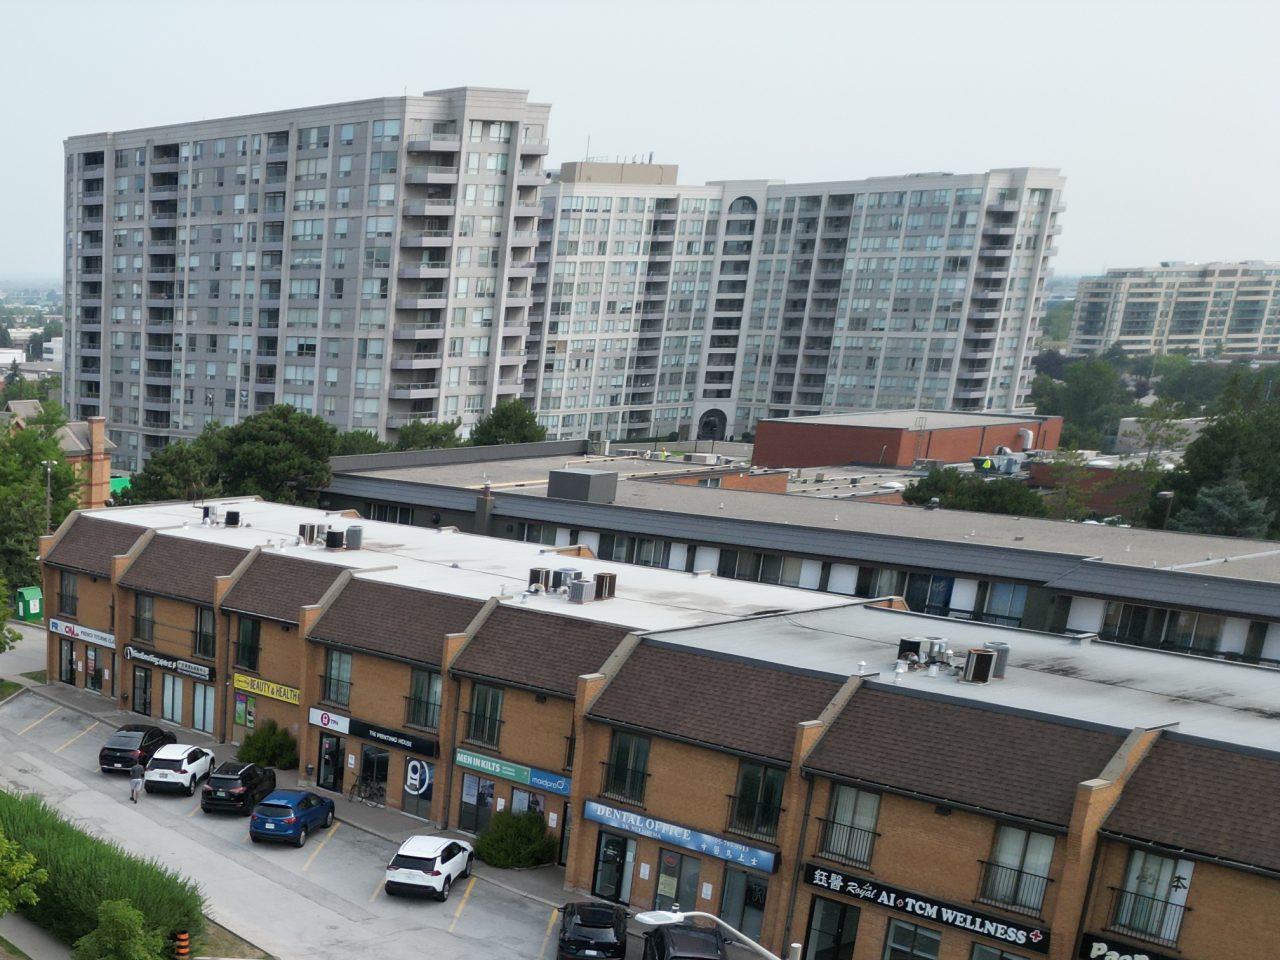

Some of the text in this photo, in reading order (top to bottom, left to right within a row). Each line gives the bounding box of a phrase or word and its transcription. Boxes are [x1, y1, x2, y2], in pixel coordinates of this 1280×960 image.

[249, 678, 271, 694] BEAUTY
[275, 686, 298, 702] HEALTH
[456, 752, 473, 765] MEN
[472, 757, 481, 767] IN
[480, 759, 501, 773] KILTS
[596, 805, 644, 828] DENTAL
[645, 818, 692, 841] OFFICE
[846, 881, 878, 899] Royal
[877, 890, 1028, 945] AI TCM WELLNESS
